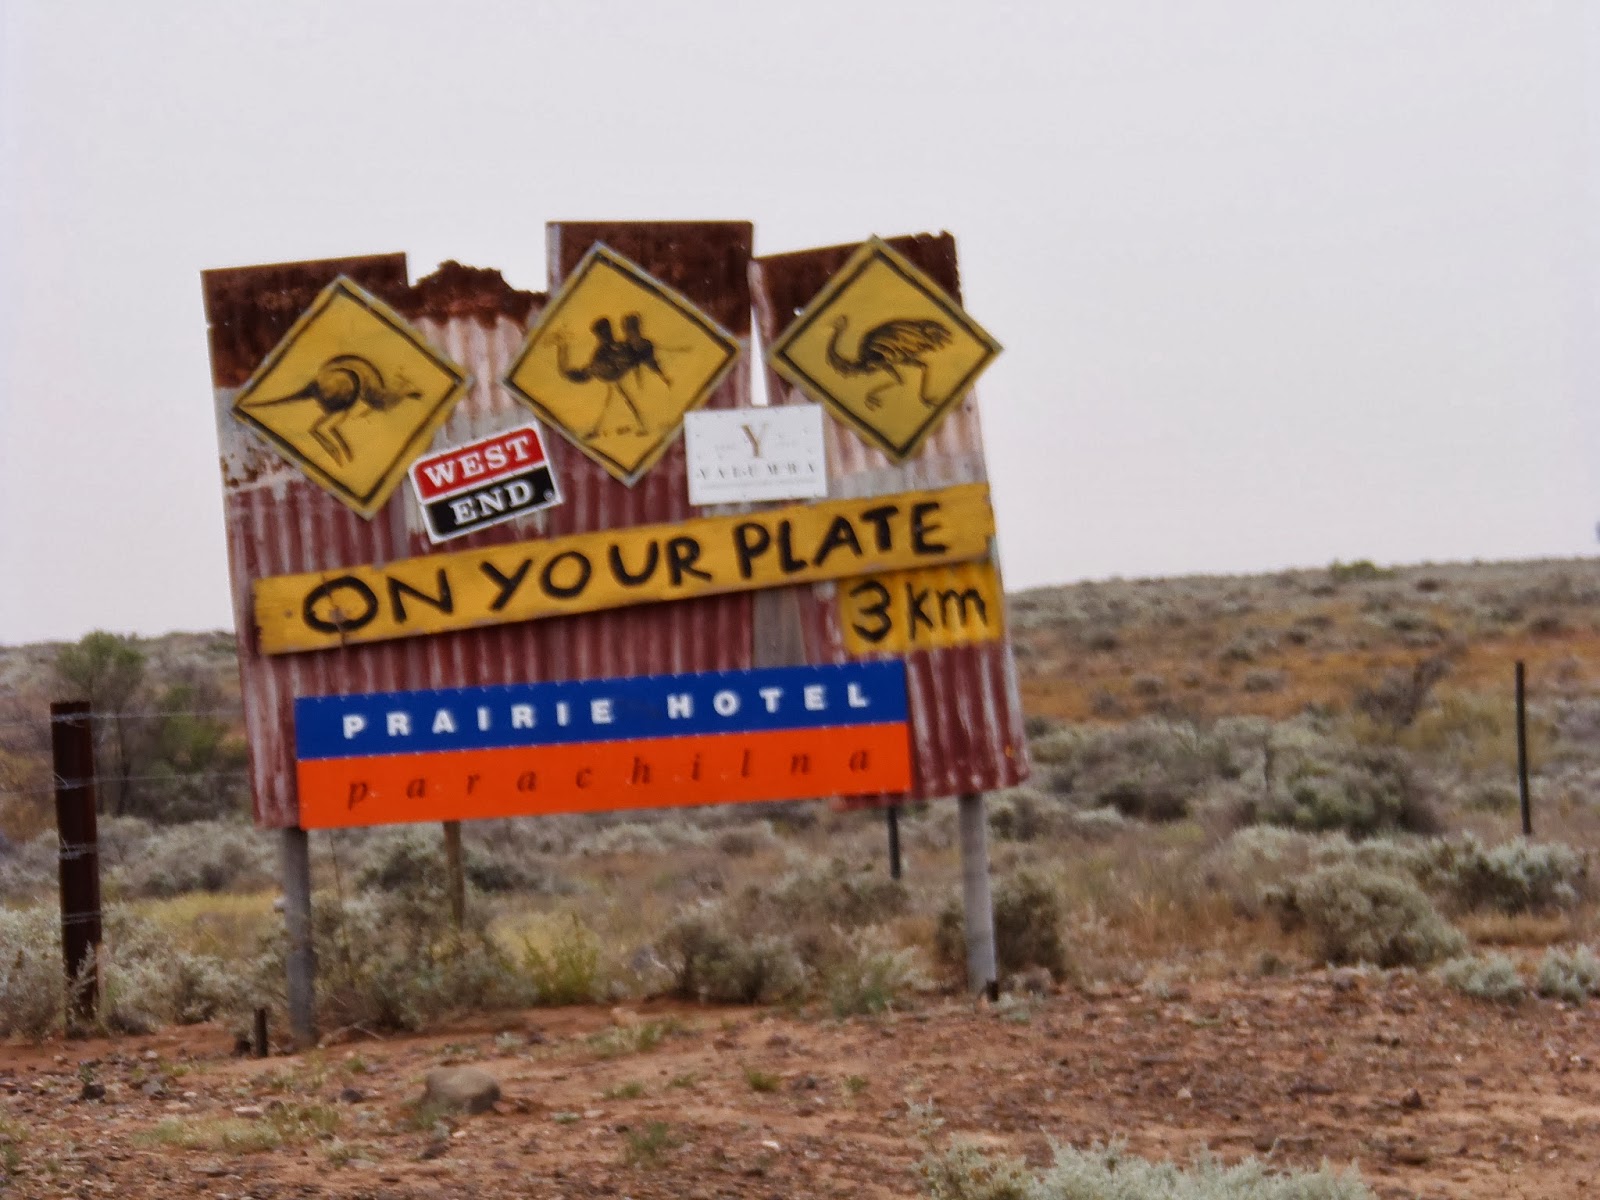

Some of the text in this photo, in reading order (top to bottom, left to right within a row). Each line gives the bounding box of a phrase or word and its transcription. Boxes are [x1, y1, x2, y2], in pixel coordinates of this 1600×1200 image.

[423, 434, 530, 489] WEST
[741, 422, 769, 459] Y
[449, 479, 534, 526] END
[302, 501, 950, 634] ON YOUR PLATE
[849, 579, 989, 643] 3 km
[342, 682, 871, 740] PRAIRIE HOTEL
[346, 746, 869, 812] parachilna
